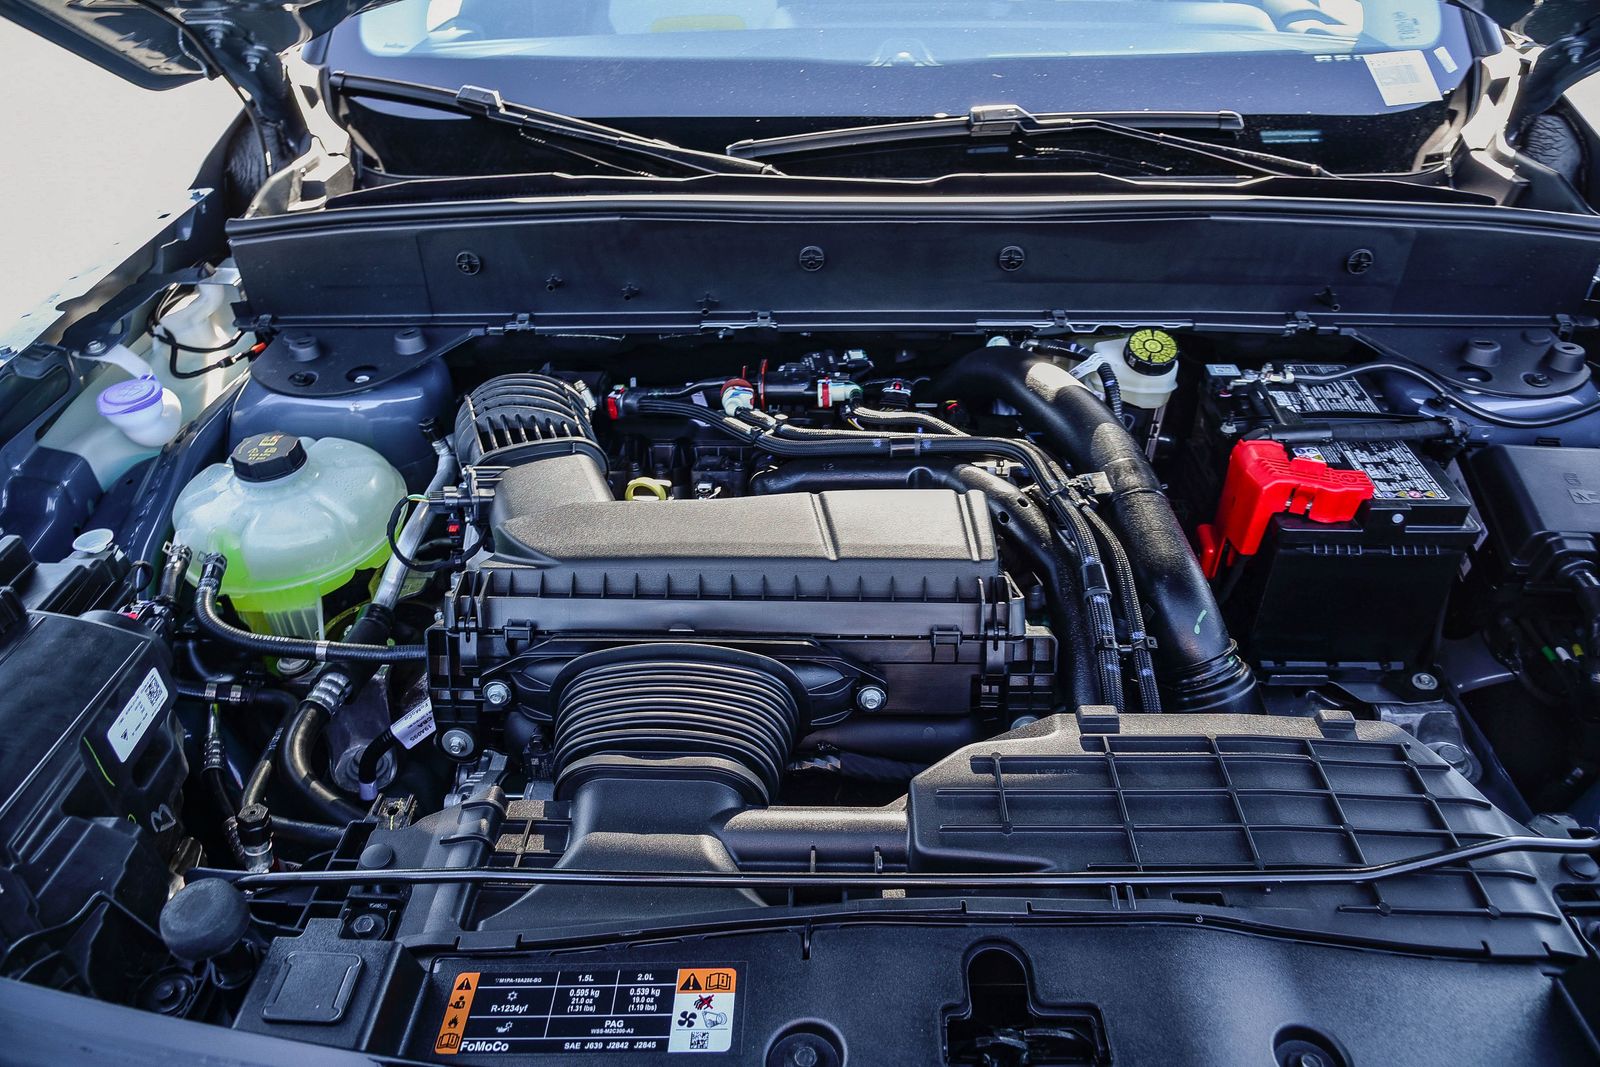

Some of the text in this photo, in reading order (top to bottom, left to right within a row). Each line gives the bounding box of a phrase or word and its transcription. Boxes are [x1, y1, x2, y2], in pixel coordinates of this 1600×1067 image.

[578, 974, 594, 982] 1.5L
[637, 973, 654, 981] 2.0L
[569, 989, 600, 998] 0.595 kg
[629, 988, 661, 997] 0.539 kg
[490, 1004, 529, 1013] R-1234yf
[567, 1005, 582, 1013] (1.31
[645, 1004, 657, 1012] lbs)
[604, 1020, 624, 1028] PAG
[460, 1041, 509, 1052] FoMoCo
[584, 1042, 603, 1050] J639
[606, 1041, 629, 1049] J2842
